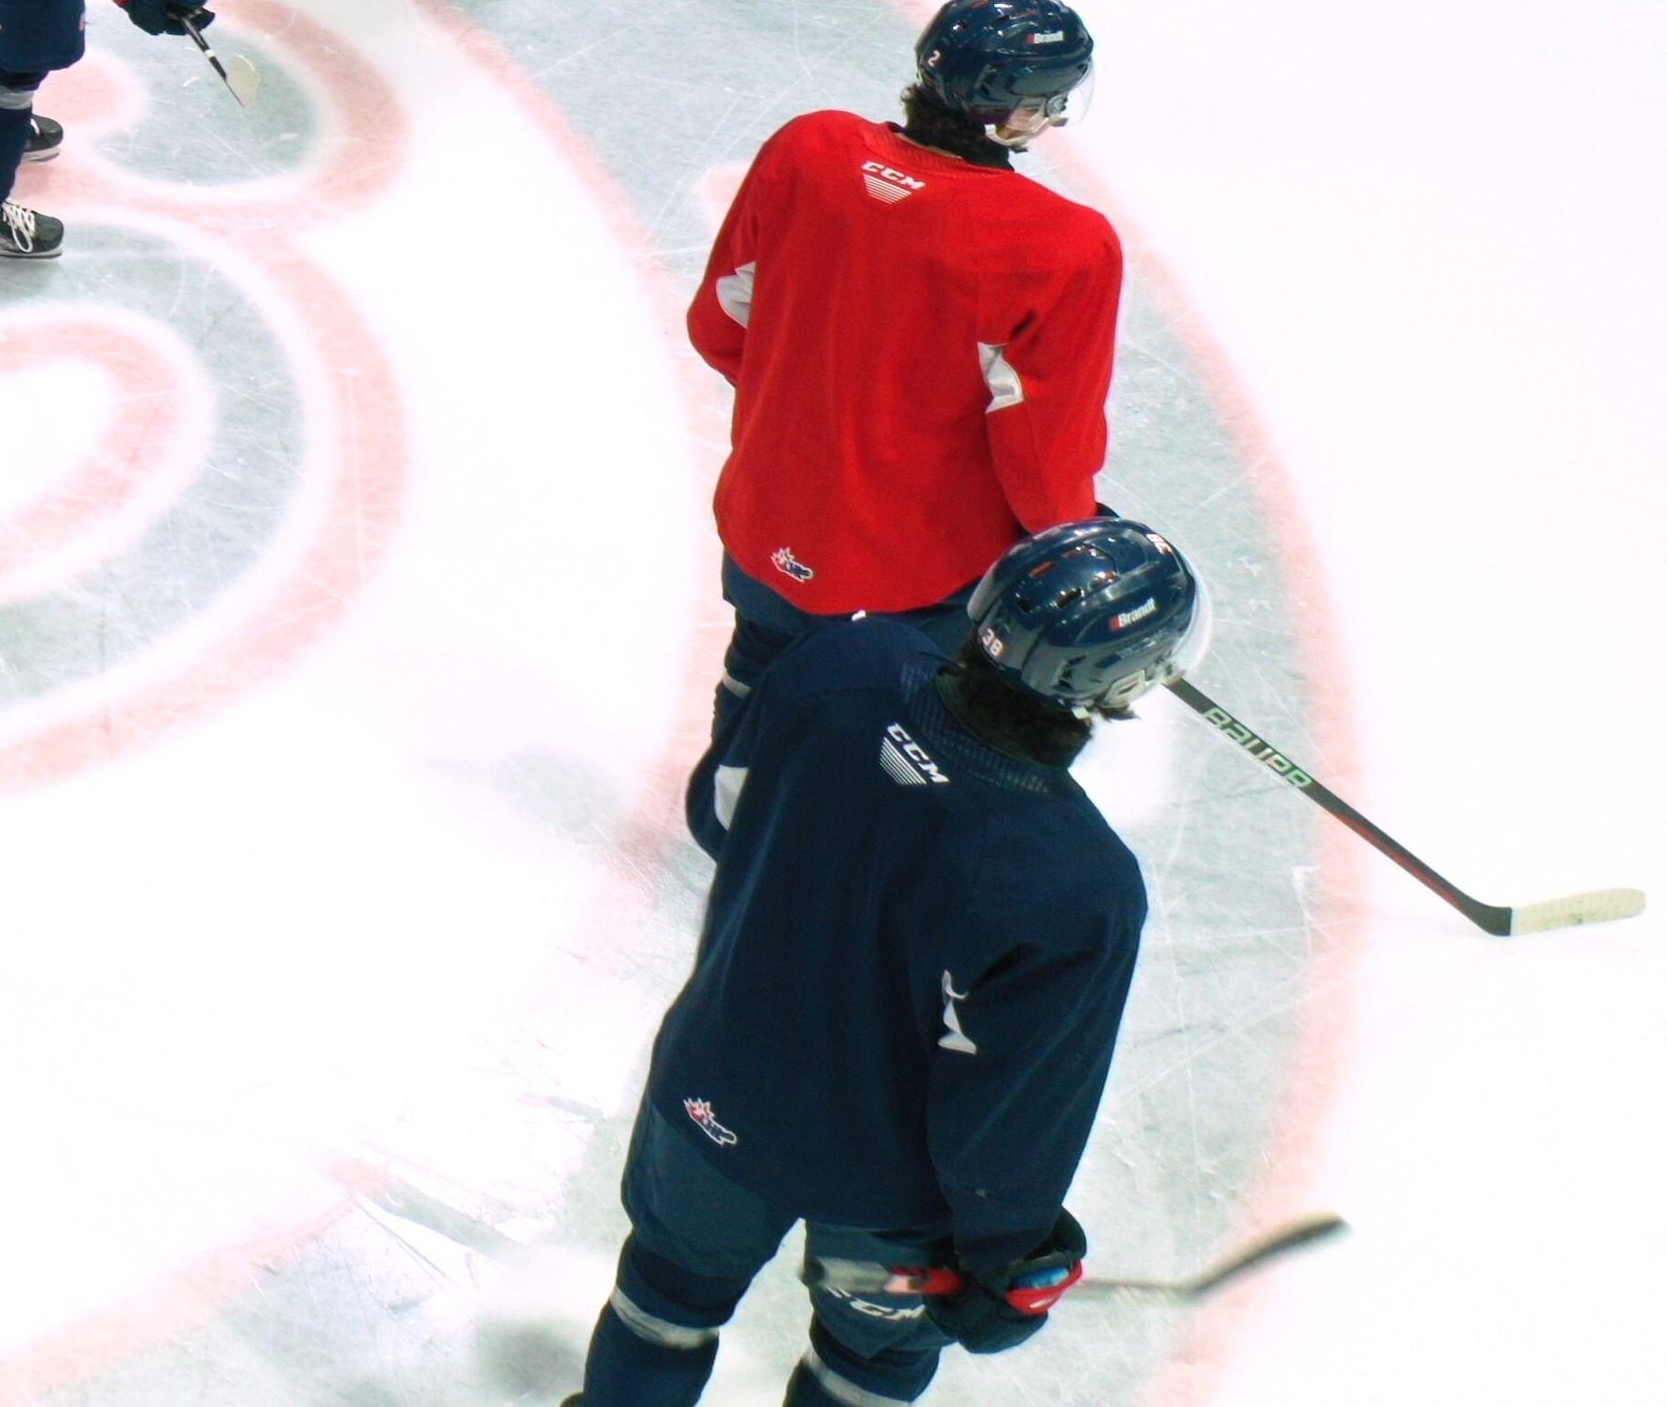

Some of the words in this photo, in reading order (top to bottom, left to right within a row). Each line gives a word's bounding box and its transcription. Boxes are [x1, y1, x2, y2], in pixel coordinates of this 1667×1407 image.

[927, 50, 941, 68] 2
[861, 159, 926, 191] CCM
[1117, 597, 1157, 630] Brandt
[981, 628, 1005, 658] 38
[886, 722, 950, 784] CCM
